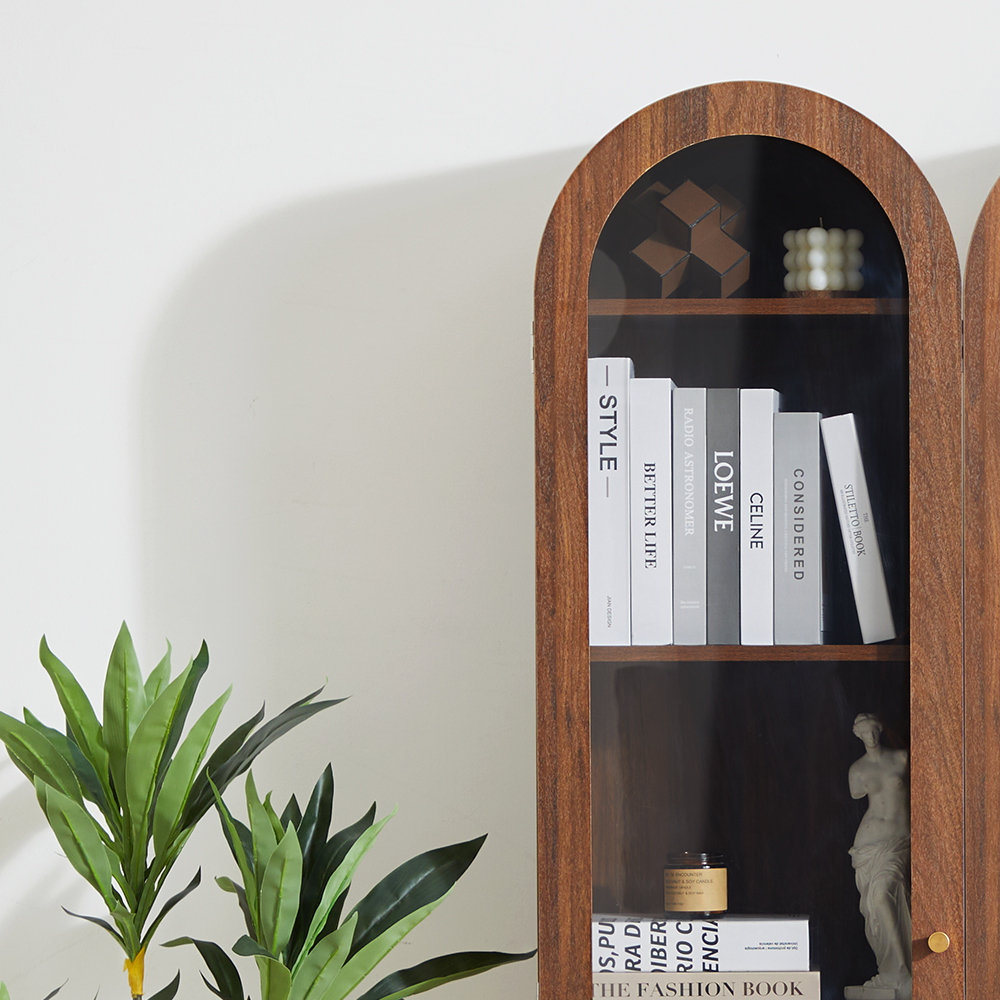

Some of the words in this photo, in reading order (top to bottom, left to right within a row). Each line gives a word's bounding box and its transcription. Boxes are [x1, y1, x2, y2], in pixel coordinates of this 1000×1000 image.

[599, 394, 618, 471] STYLE
[683, 407, 694, 448] RADIO
[643, 463, 656, 527] BETTER
[683, 451, 695, 536] ASTRONOMER
[713, 450, 734, 533] LOEWE
[749, 492, 764, 550] CELINE
[793, 468, 805, 581] CONSIDERED
[844, 483, 860, 528] STILETTO
[853, 530, 866, 557] BOOK
[644, 532, 656, 569] LIFE
[638, 982, 735, 997] FASHION
[743, 981, 804, 997] BOOK
